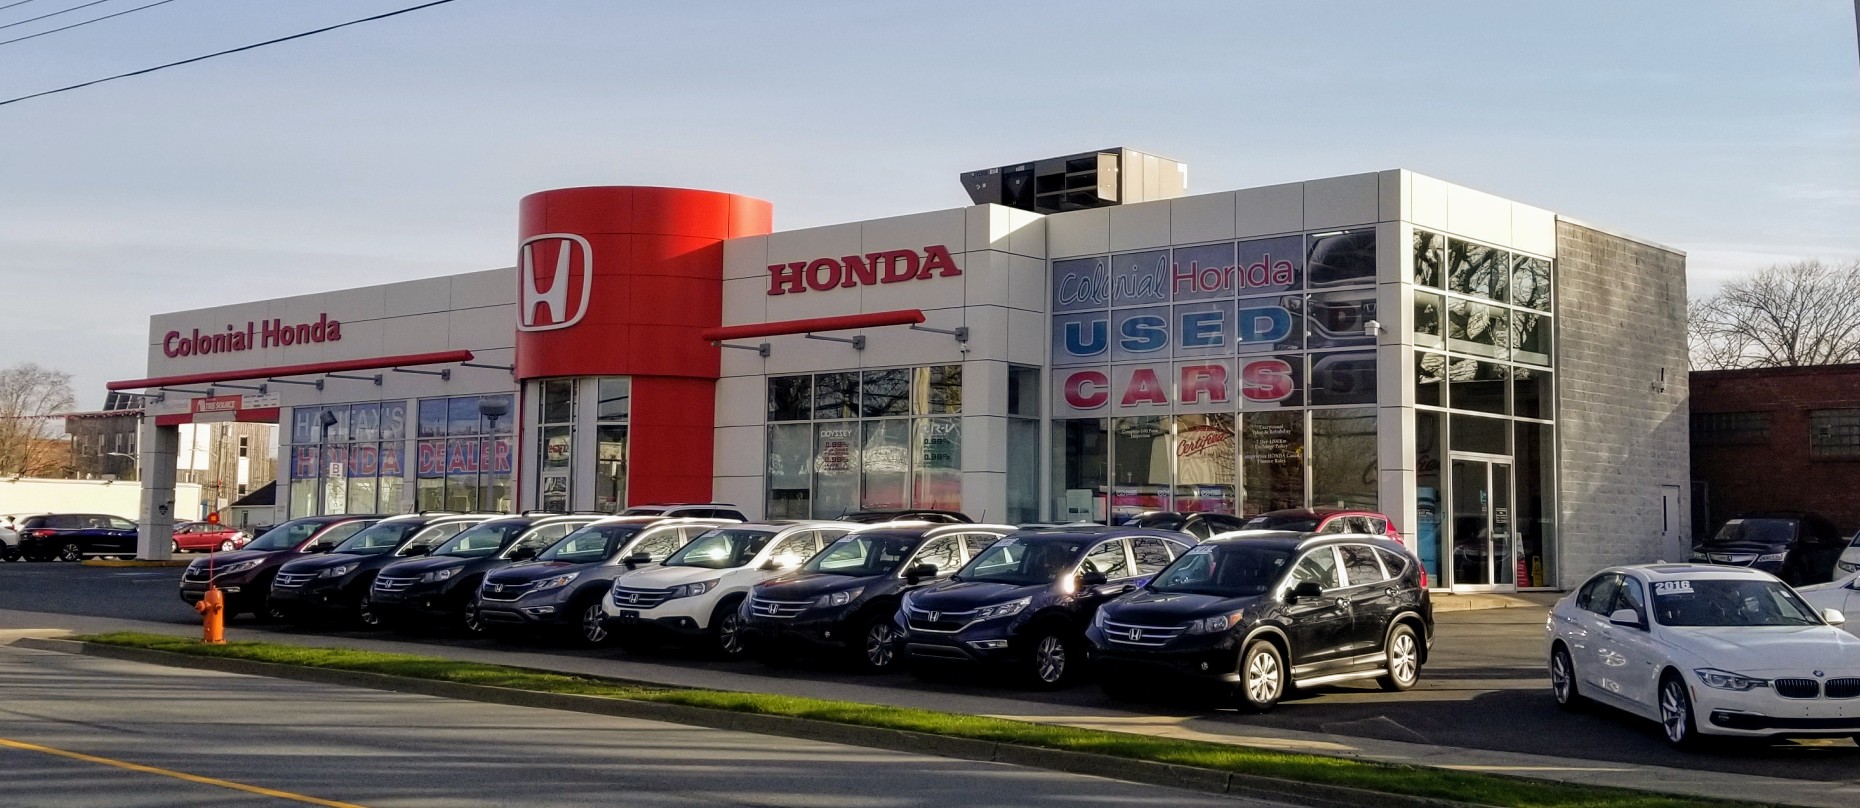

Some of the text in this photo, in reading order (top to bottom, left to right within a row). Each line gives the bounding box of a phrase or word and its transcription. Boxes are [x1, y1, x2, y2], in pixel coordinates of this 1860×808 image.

[767, 244, 962, 296] HONDA
[1059, 253, 1294, 306] Colonial Honda
[163, 313, 341, 358] Colonial Honda
[1064, 305, 1293, 357] USED
[1064, 359, 1294, 410] CARS
[297, 407, 404, 438] HAIFAX'S
[821, 429, 852, 438] ODYSSEY
[419, 439, 510, 474] DEALER
[1177, 432, 1229, 457] Certified
[332, 463, 340, 473] B
[1655, 580, 1691, 590] 2016
